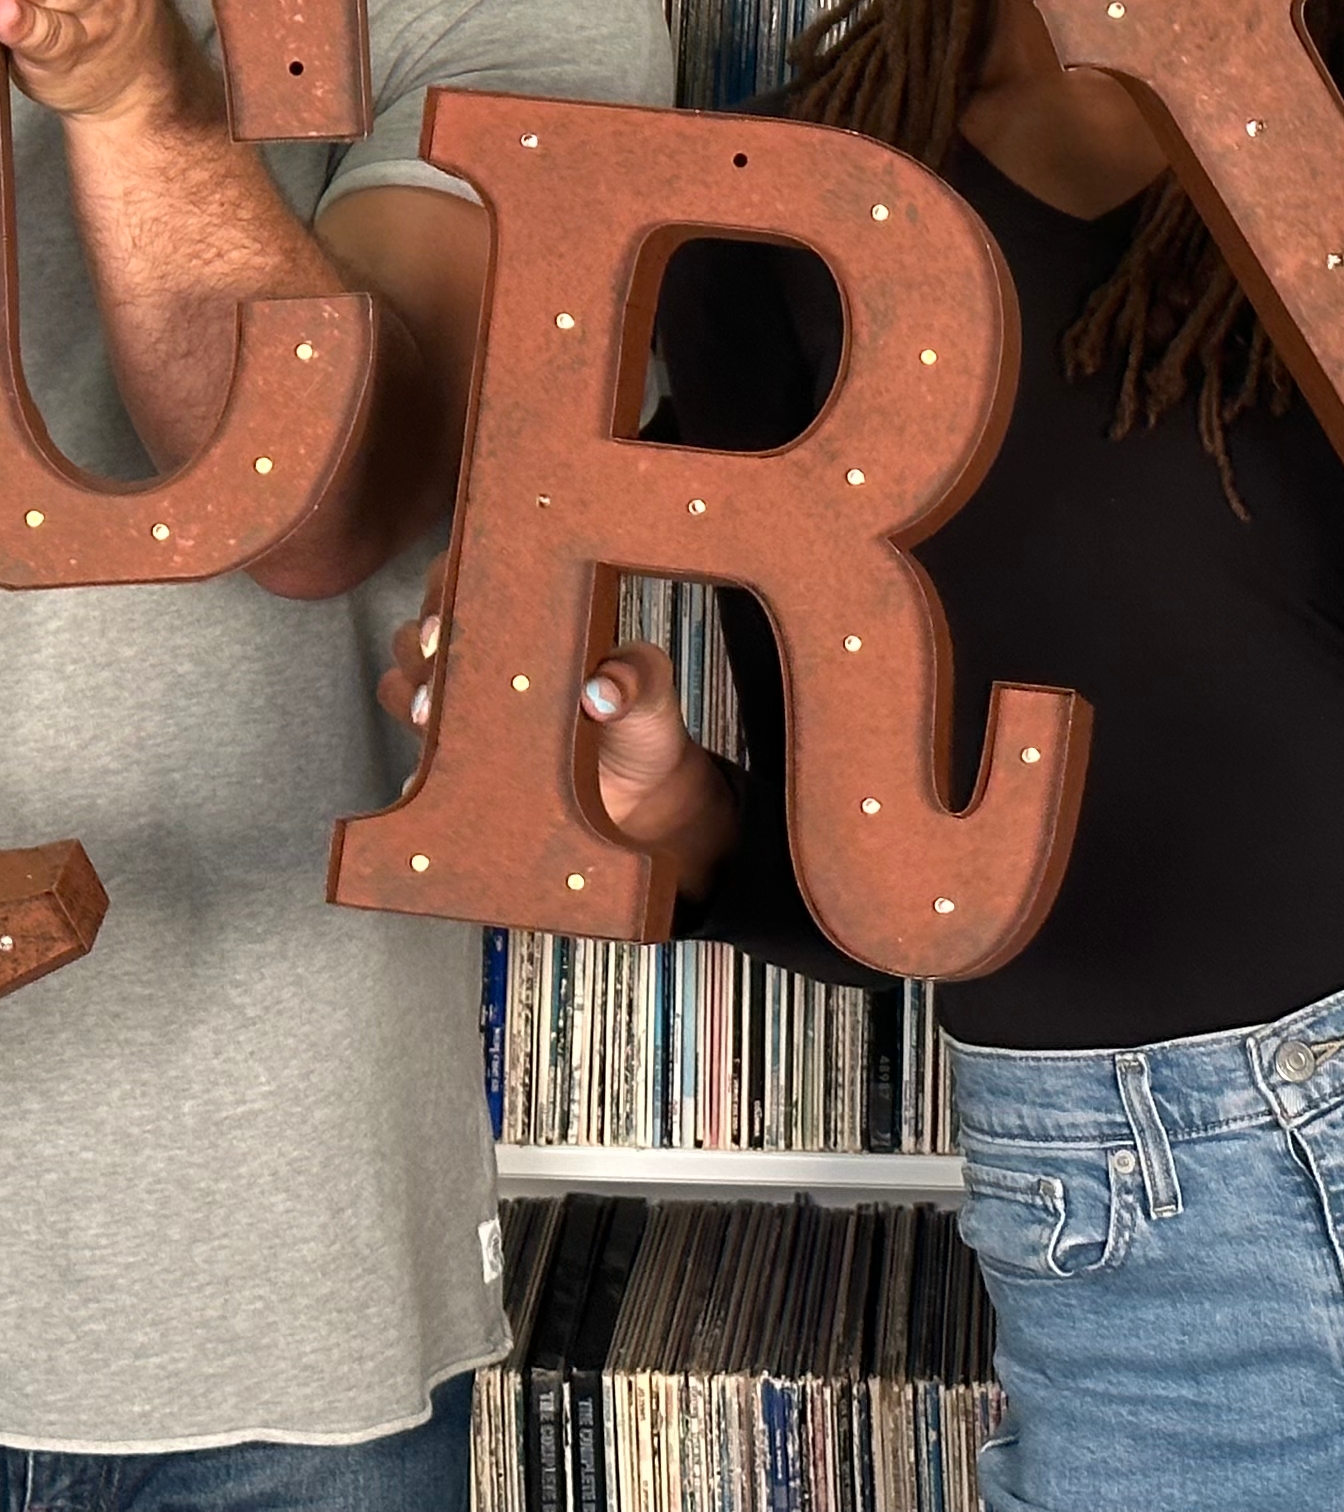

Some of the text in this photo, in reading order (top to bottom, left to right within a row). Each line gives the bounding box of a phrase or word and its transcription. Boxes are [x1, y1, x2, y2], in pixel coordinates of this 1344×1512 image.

[327, 87, 1091, 977] R
[538, 1390, 555, 1422] THE
[578, 1396, 594, 1426] THE
[539, 1423, 557, 1501] COMPLETE
[579, 1427, 596, 1501] COMPLETE
